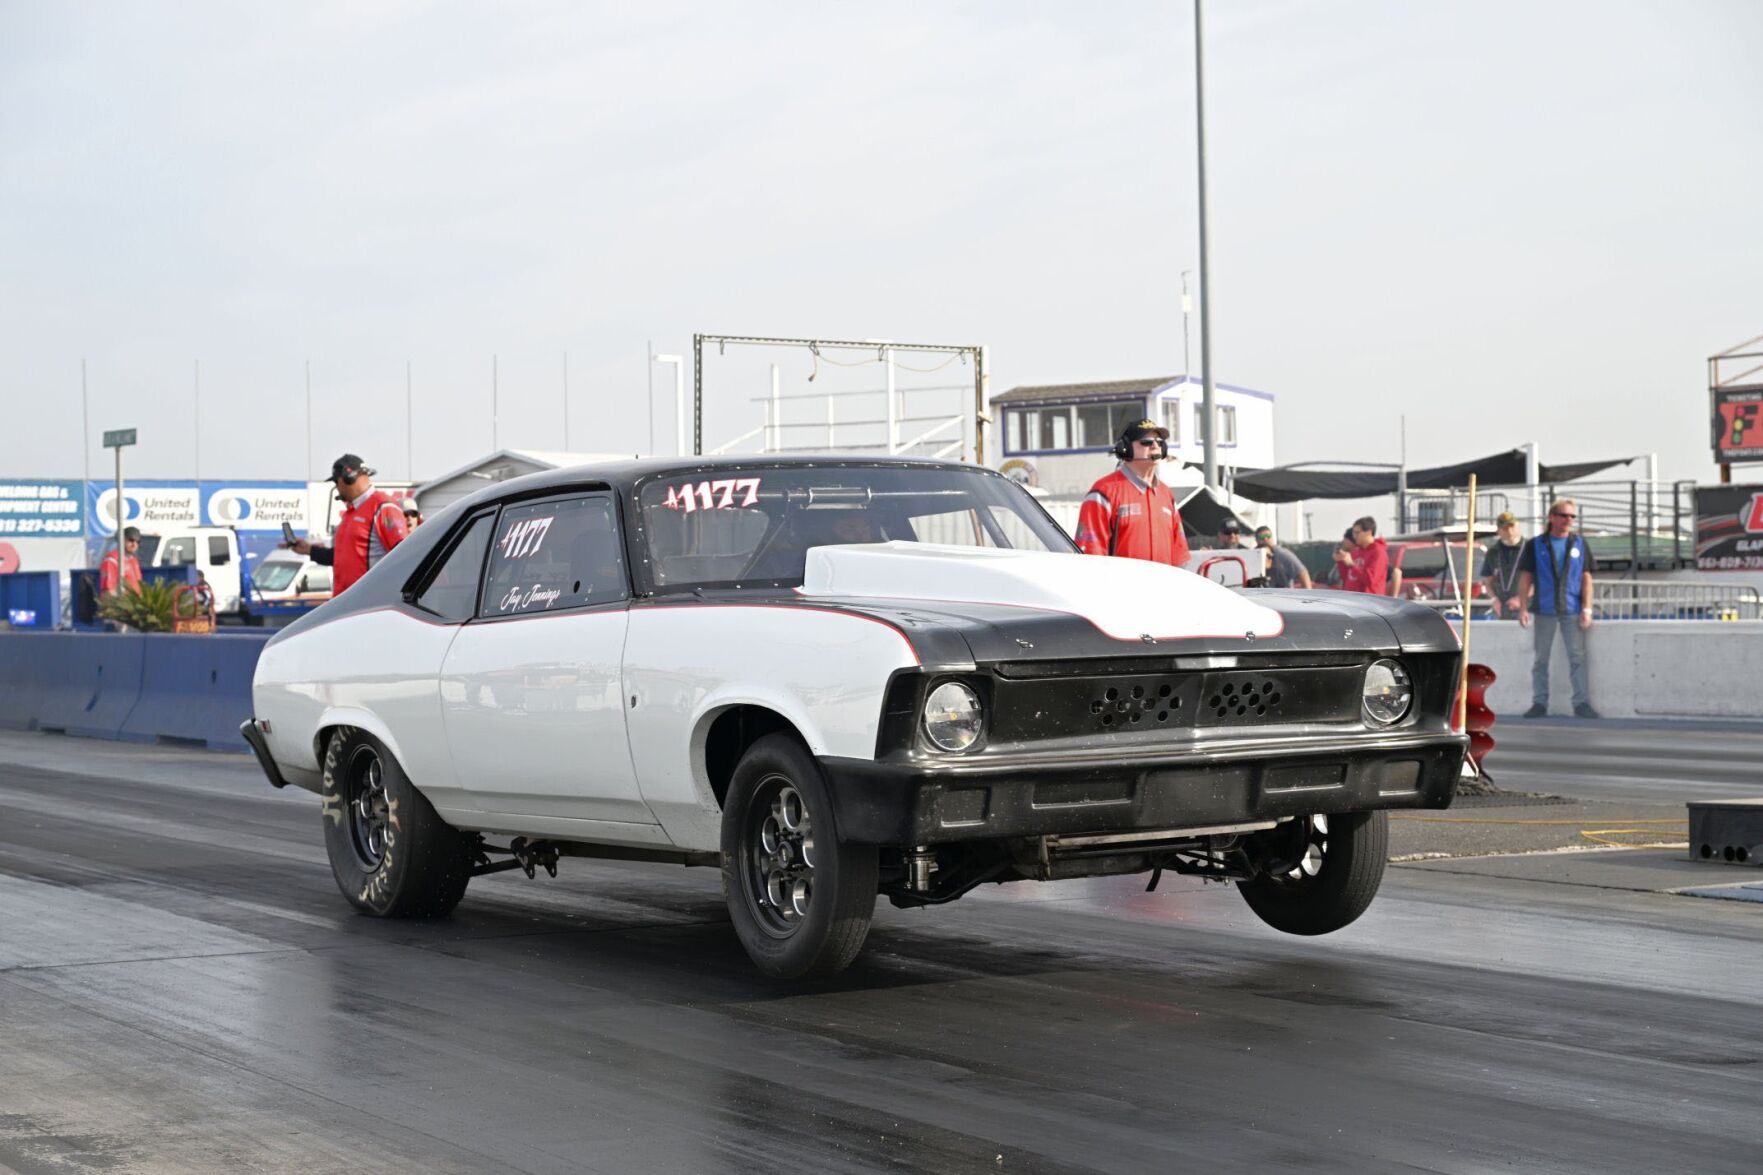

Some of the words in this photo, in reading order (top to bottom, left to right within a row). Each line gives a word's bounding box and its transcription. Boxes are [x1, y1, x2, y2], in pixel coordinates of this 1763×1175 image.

[144, 498, 191, 509] United
[255, 498, 300, 509] United
[144, 510, 195, 521] Rentals
[255, 510, 304, 521] Rentals
[500, 586, 522, 613] Jay
[521, 584, 561, 609] Jennings
